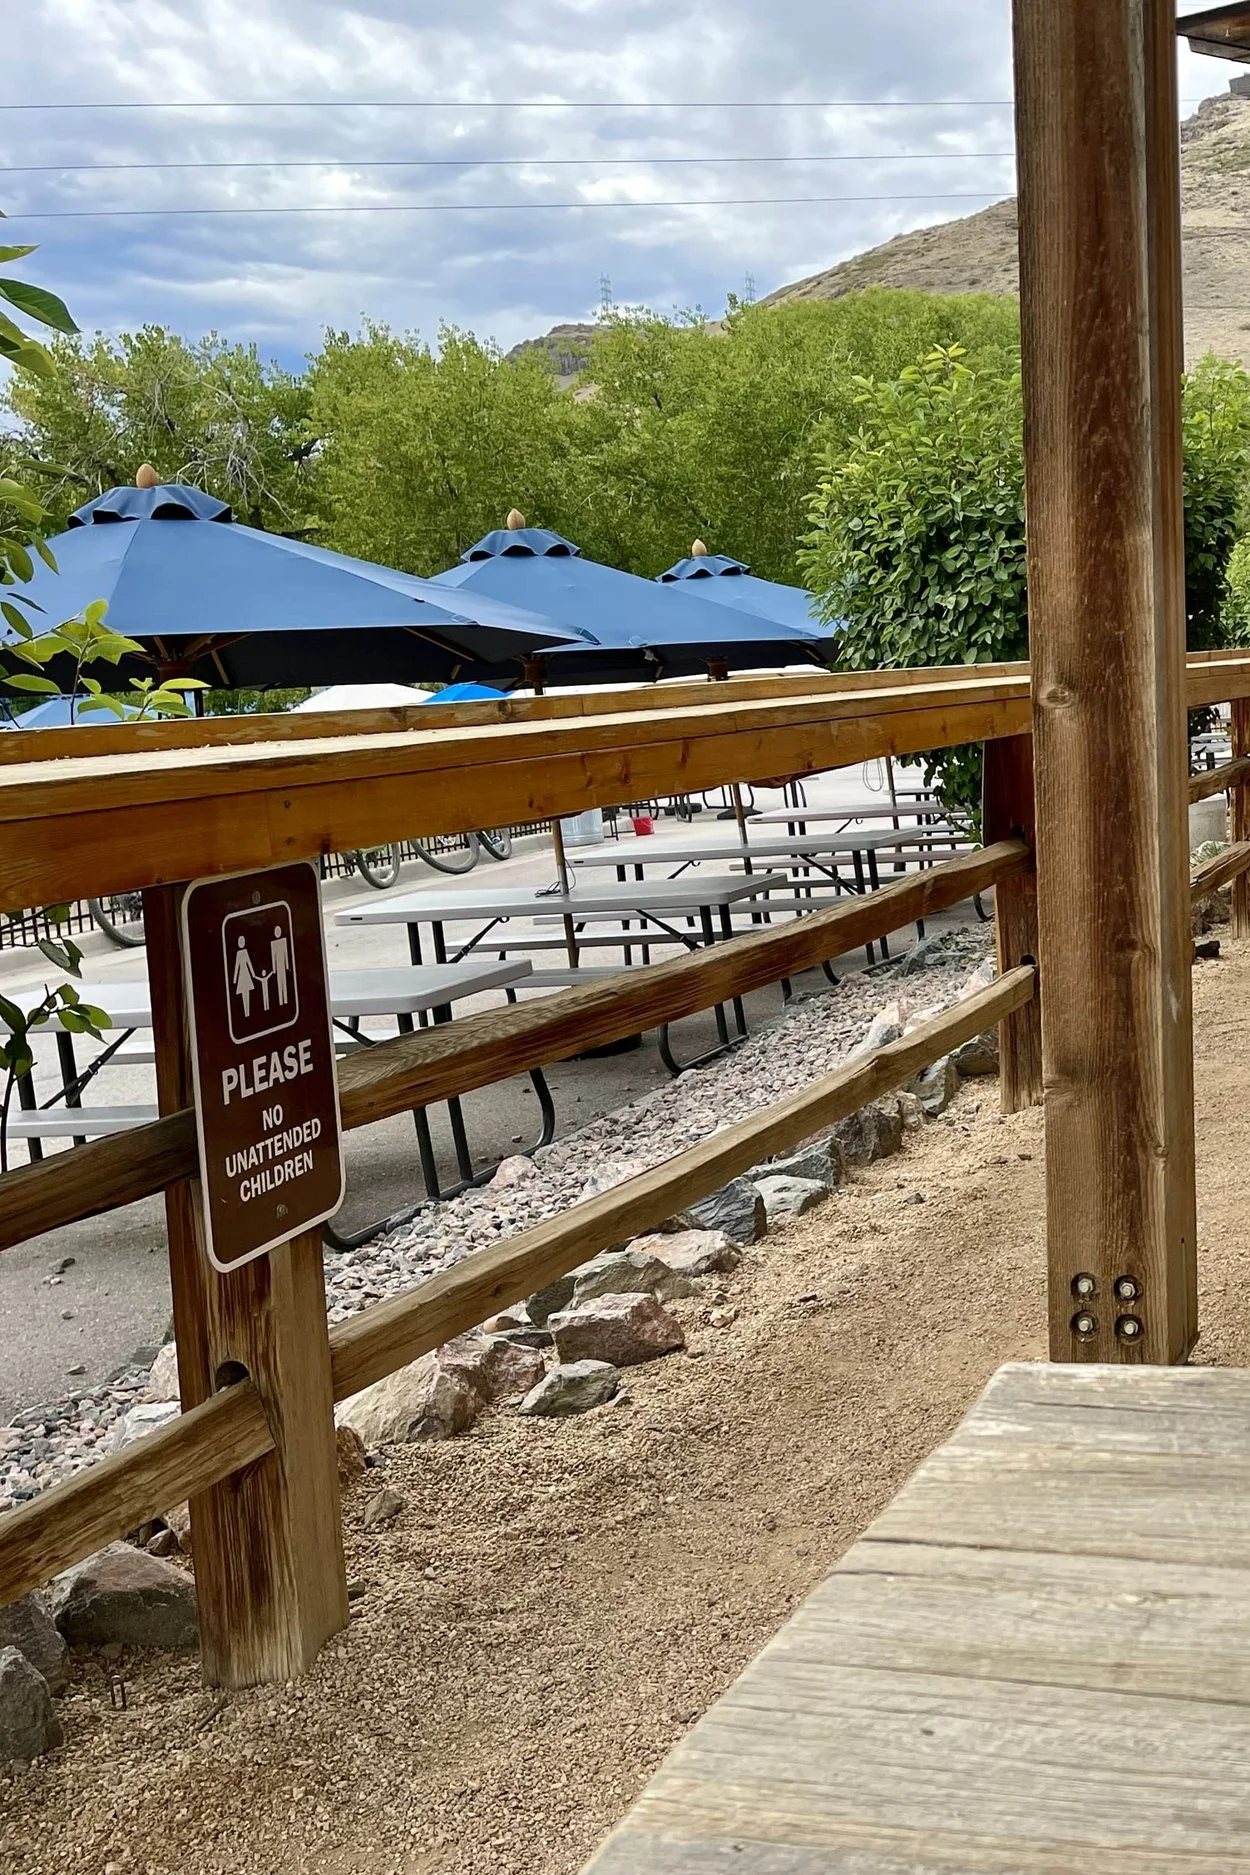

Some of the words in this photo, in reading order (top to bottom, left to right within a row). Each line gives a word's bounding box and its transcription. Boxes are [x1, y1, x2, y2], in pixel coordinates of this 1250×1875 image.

[221, 1039, 313, 1106] PLEASE
[262, 1104, 283, 1131] NO
[225, 1118, 321, 1178] UNATTENDED
[240, 1150, 313, 1202] CHILDREN
